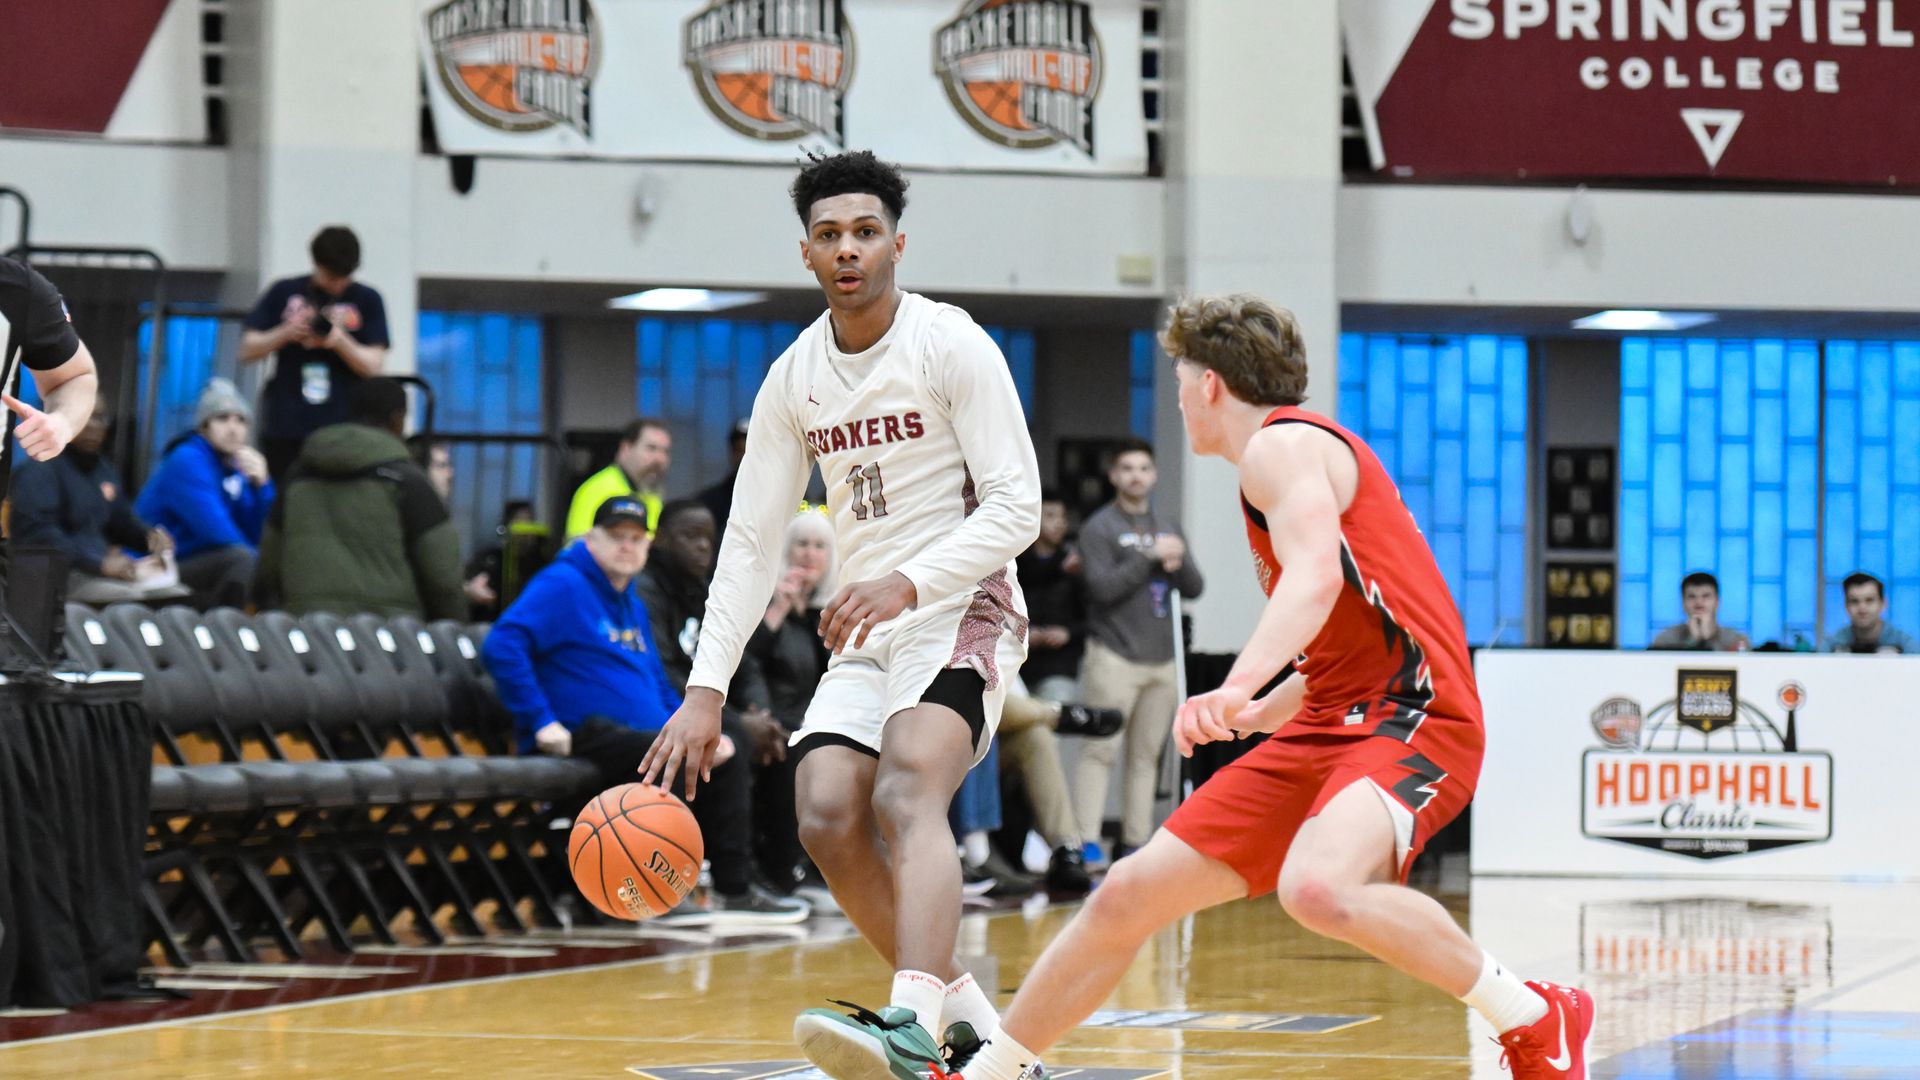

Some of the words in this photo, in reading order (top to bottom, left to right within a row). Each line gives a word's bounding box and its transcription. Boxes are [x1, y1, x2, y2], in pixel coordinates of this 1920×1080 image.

[1579, 57, 1840, 93] COLLEGE
[807, 411, 925, 457] QUAKERS
[845, 461, 889, 520] 11
[1597, 762, 1821, 810] HOOPHALL
[1660, 802, 1750, 831] Classic
